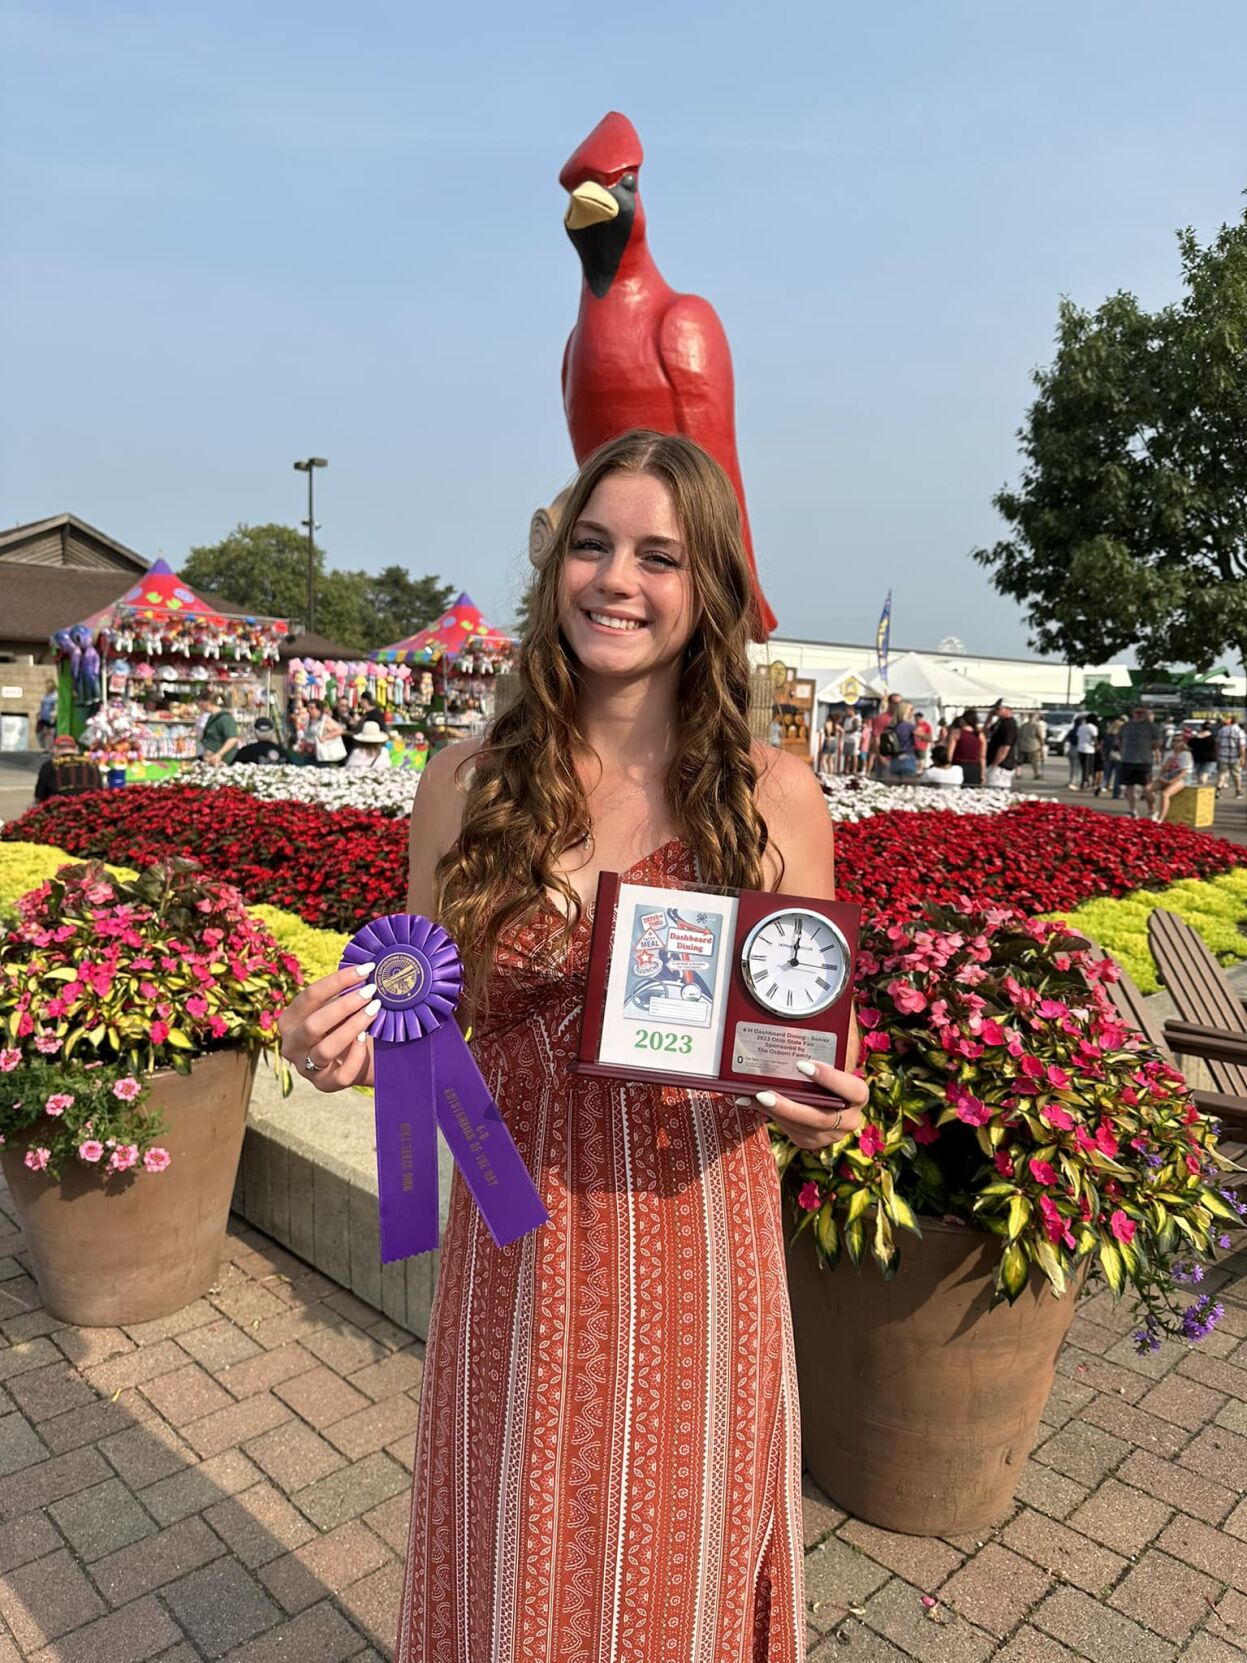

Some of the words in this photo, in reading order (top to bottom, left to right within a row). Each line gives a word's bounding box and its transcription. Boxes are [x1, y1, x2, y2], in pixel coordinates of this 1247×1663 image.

[640, 940, 660, 948] MEAL
[670, 932, 712, 944] Dashboard
[676, 942, 704, 953] Dining
[753, 1028, 786, 1038] Dashboard
[786, 1033, 806, 1041] Dining
[634, 1029, 693, 1054] 2023
[765, 1042, 797, 1051] Sponsored
[769, 1048, 791, 1056] Osborn
[792, 1051, 812, 1060] Family
[444, 1087, 475, 1141] OUTSTANDING
[470, 1141, 483, 1152] OF
